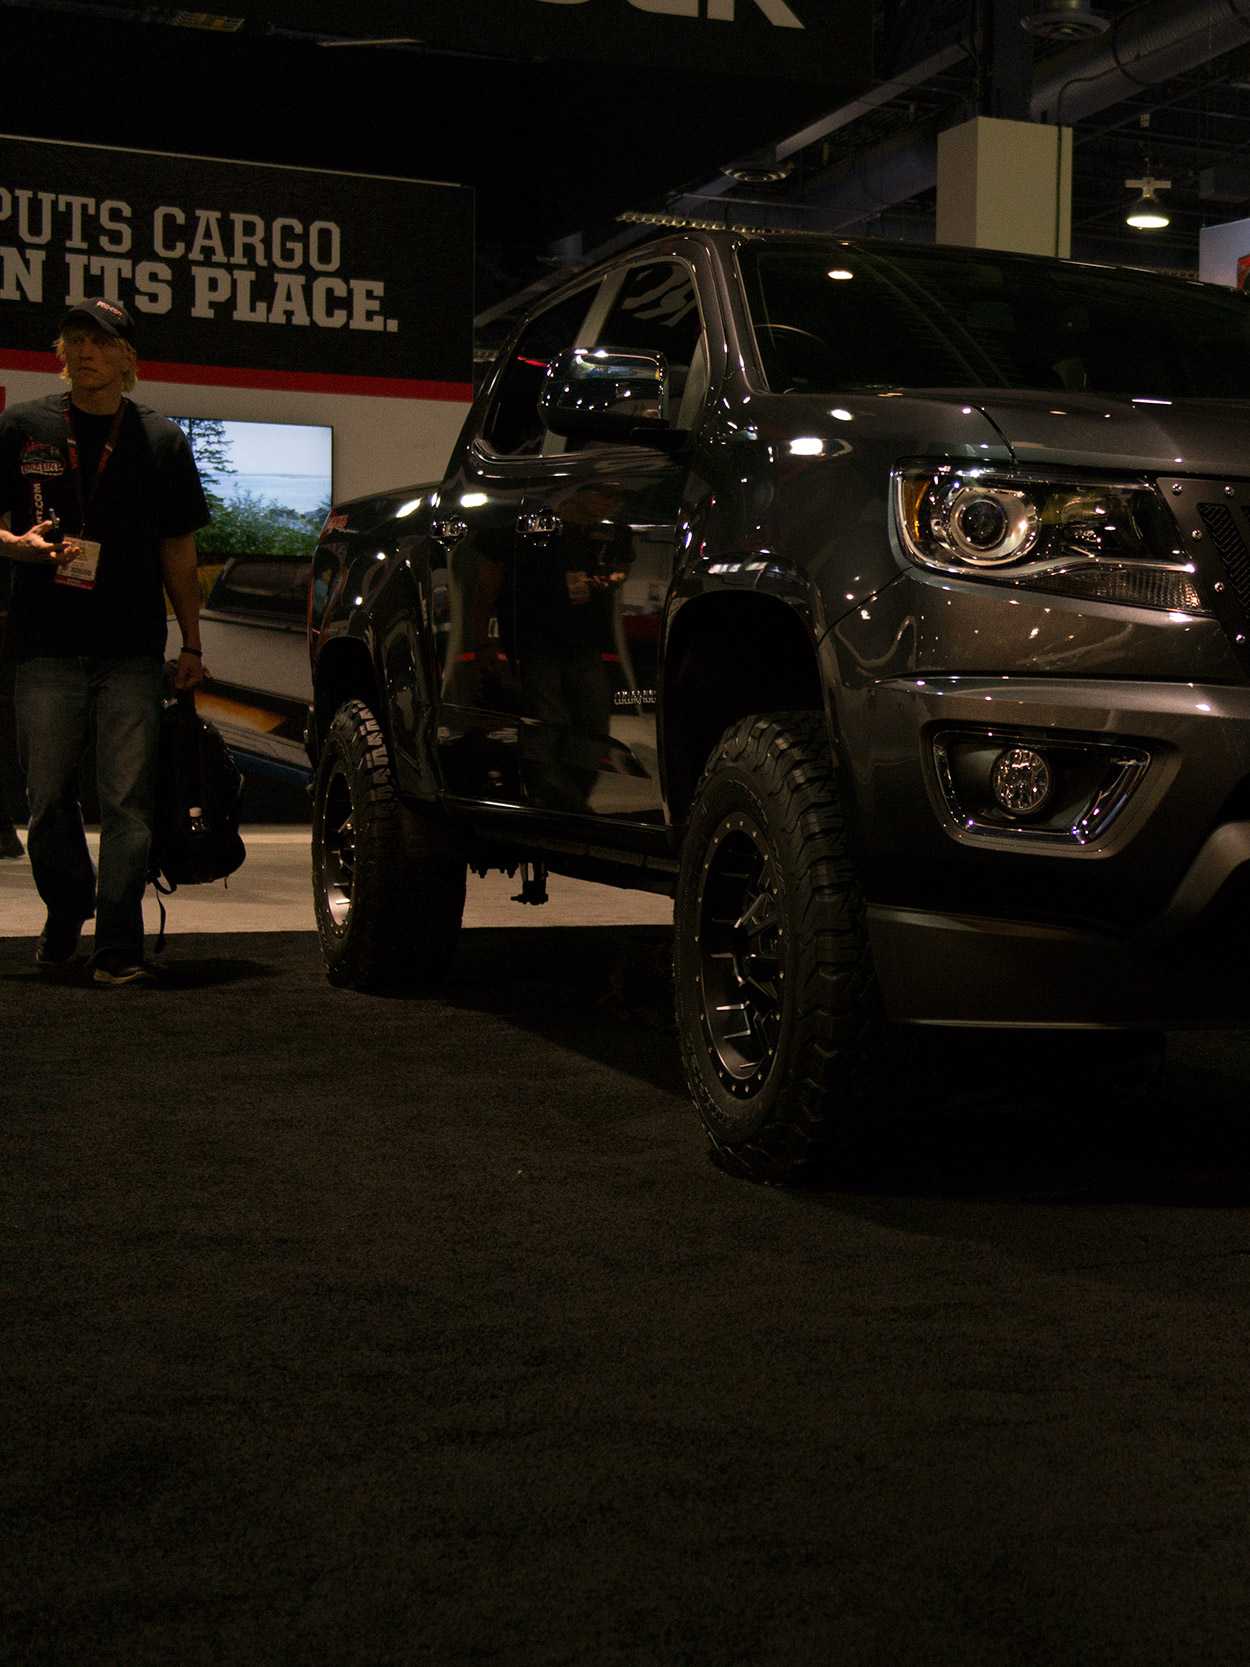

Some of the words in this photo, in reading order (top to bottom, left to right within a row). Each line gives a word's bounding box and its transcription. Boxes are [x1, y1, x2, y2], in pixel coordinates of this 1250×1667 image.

[153, 205, 342, 273] CARGO
[64, 252, 173, 314] ITS
[190, 265, 399, 333] PLACE.
